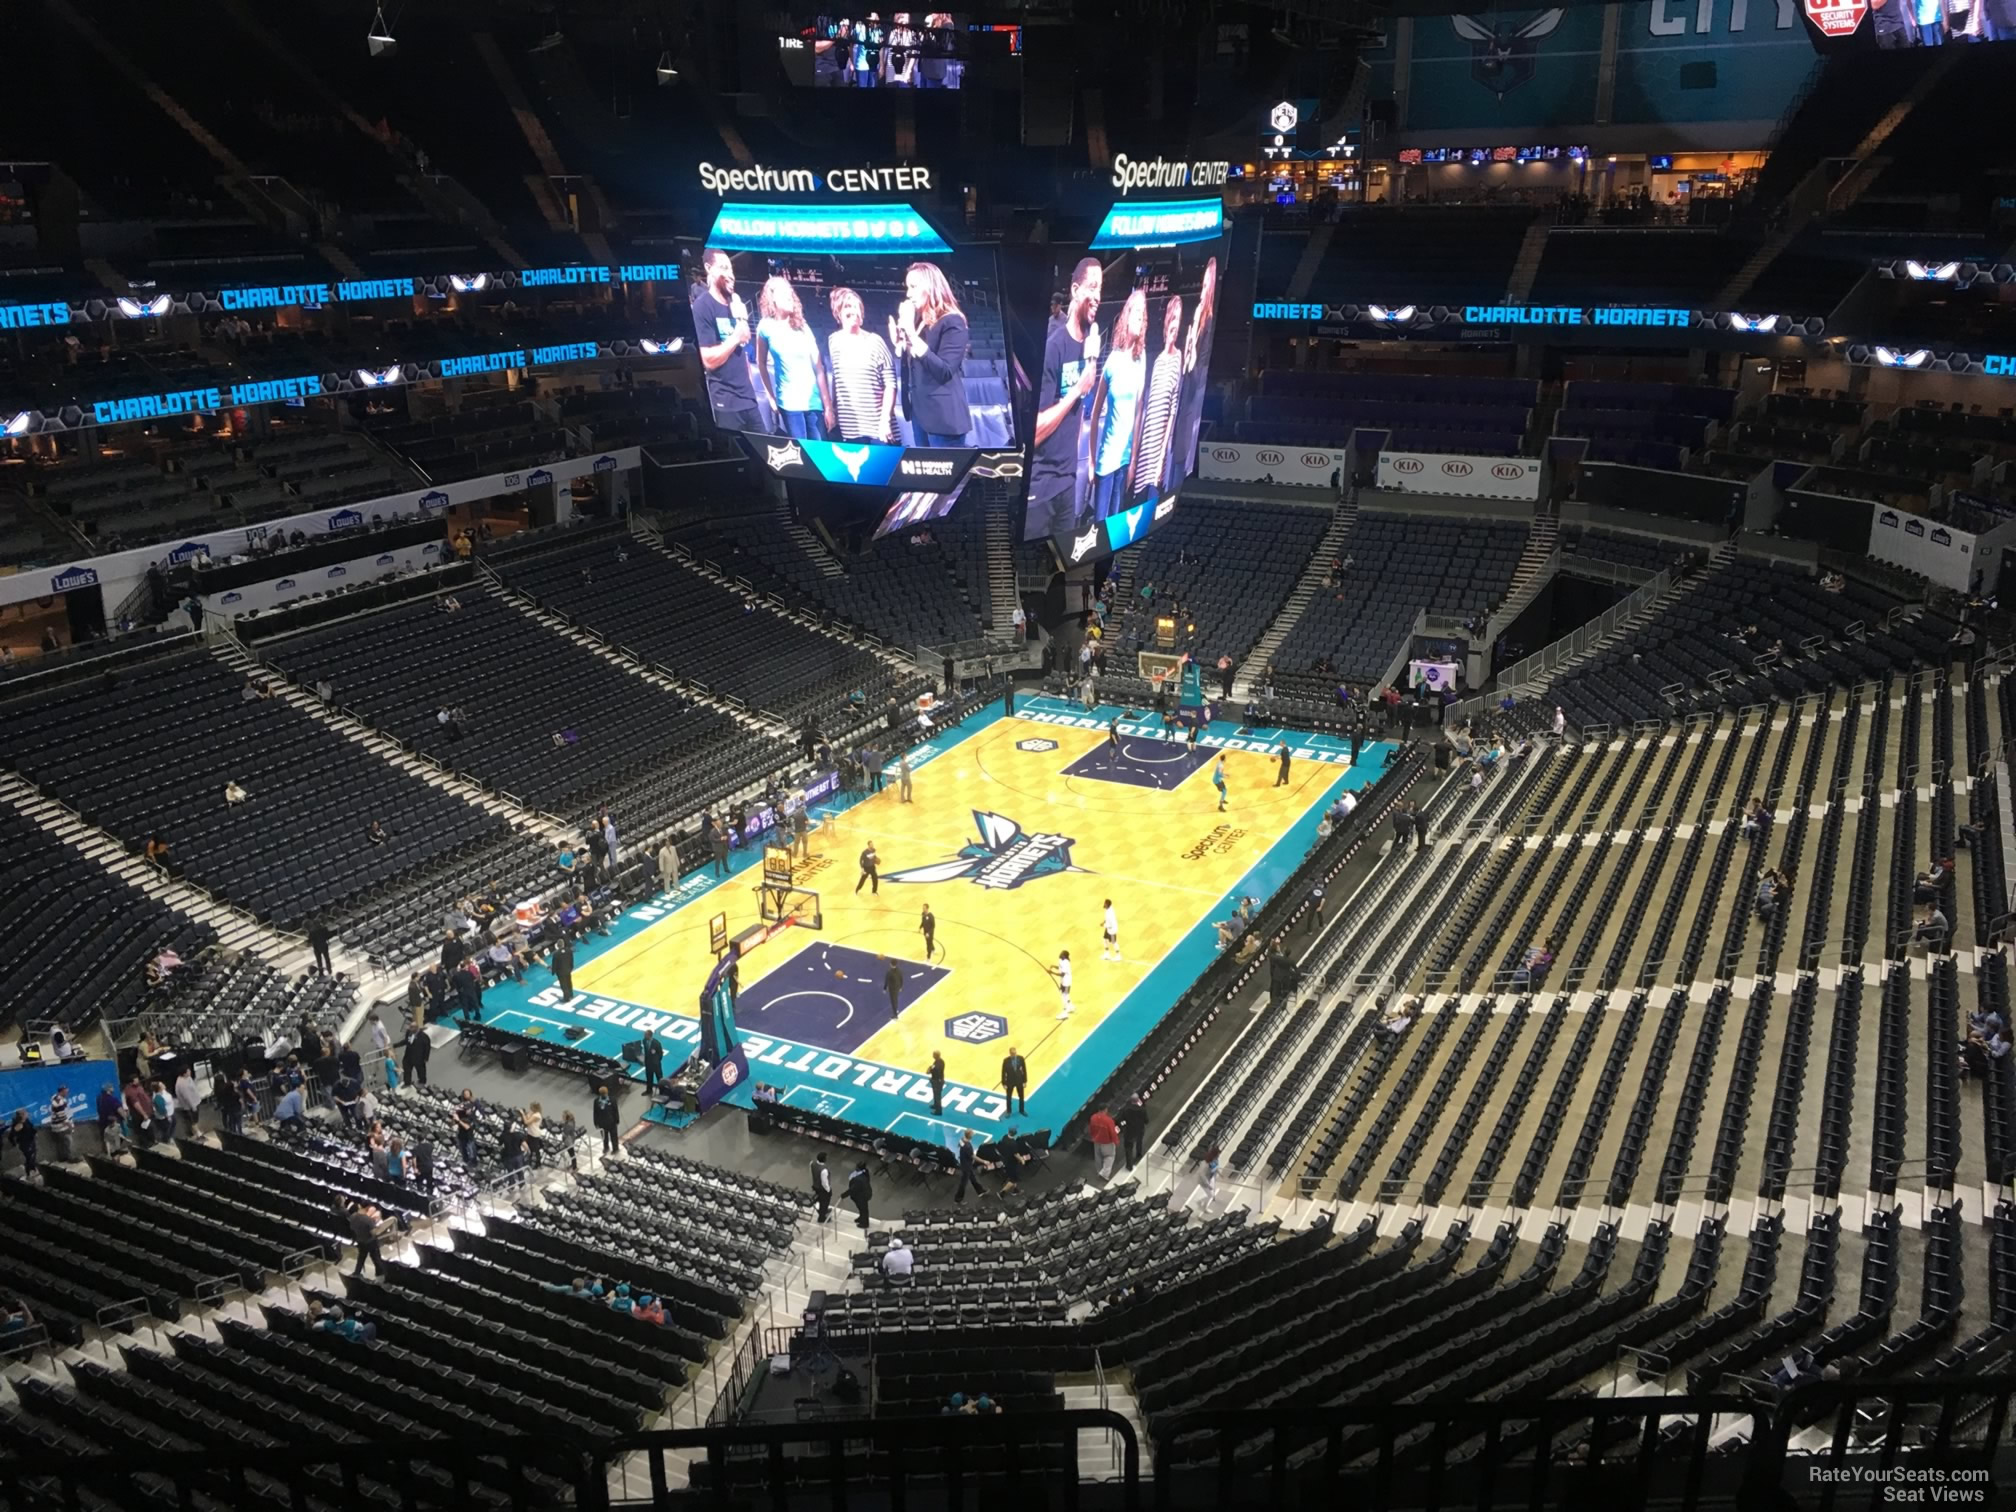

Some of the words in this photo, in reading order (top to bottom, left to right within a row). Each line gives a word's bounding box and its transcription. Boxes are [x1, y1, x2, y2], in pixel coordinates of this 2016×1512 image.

[1821, 10, 1854, 21] SECURITY
[1822, 20, 1856, 30] SYSTEMS
[698, 161, 816, 197] Spectrum
[826, 166, 932, 193] CENTER
[1112, 153, 1188, 197] Spectrum
[1191, 161, 1229, 187] CENTER
[521, 266, 611, 287] CHARLOTTE
[620, 264, 680, 283] HORNE
[221, 283, 329, 310] CHARLOTTE
[337, 277, 415, 302] HORNETS
[1465, 306, 1582, 325] CHARLOTTE
[1595, 308, 1690, 327] HORNETS
[440, 350, 526, 378] CHARLOTTE
[533, 342, 598, 366] HORNETS
[93, 387, 220, 424] CHARLOTTE
[230, 375, 320, 406] HORNETS
[1217, 450, 1236, 460] KIA
[1261, 453, 1280, 463] KIA
[1305, 456, 1325, 466] KIA
[1398, 460, 1418, 472] KIA
[1446, 463, 1467, 474] KIA
[1497, 466, 1518, 478] KIA
[505, 475, 519, 487] 106
[421, 496, 448, 510] OWE'S
[331, 513, 361, 530] LOWE'S
[54, 571, 95, 589] LOWE'S
[1181, 825, 1228, 860] Spectrum
[1213, 829, 1246, 854] CENTER
[975, 833, 1068, 889] HORNETS
[953, 1014, 986, 1038] BUZZ
[968, 1018, 1000, 1040] CITY
[724, 1068, 737, 1080] CPI
[743, 1036, 1007, 1120] CHARLOTTE
